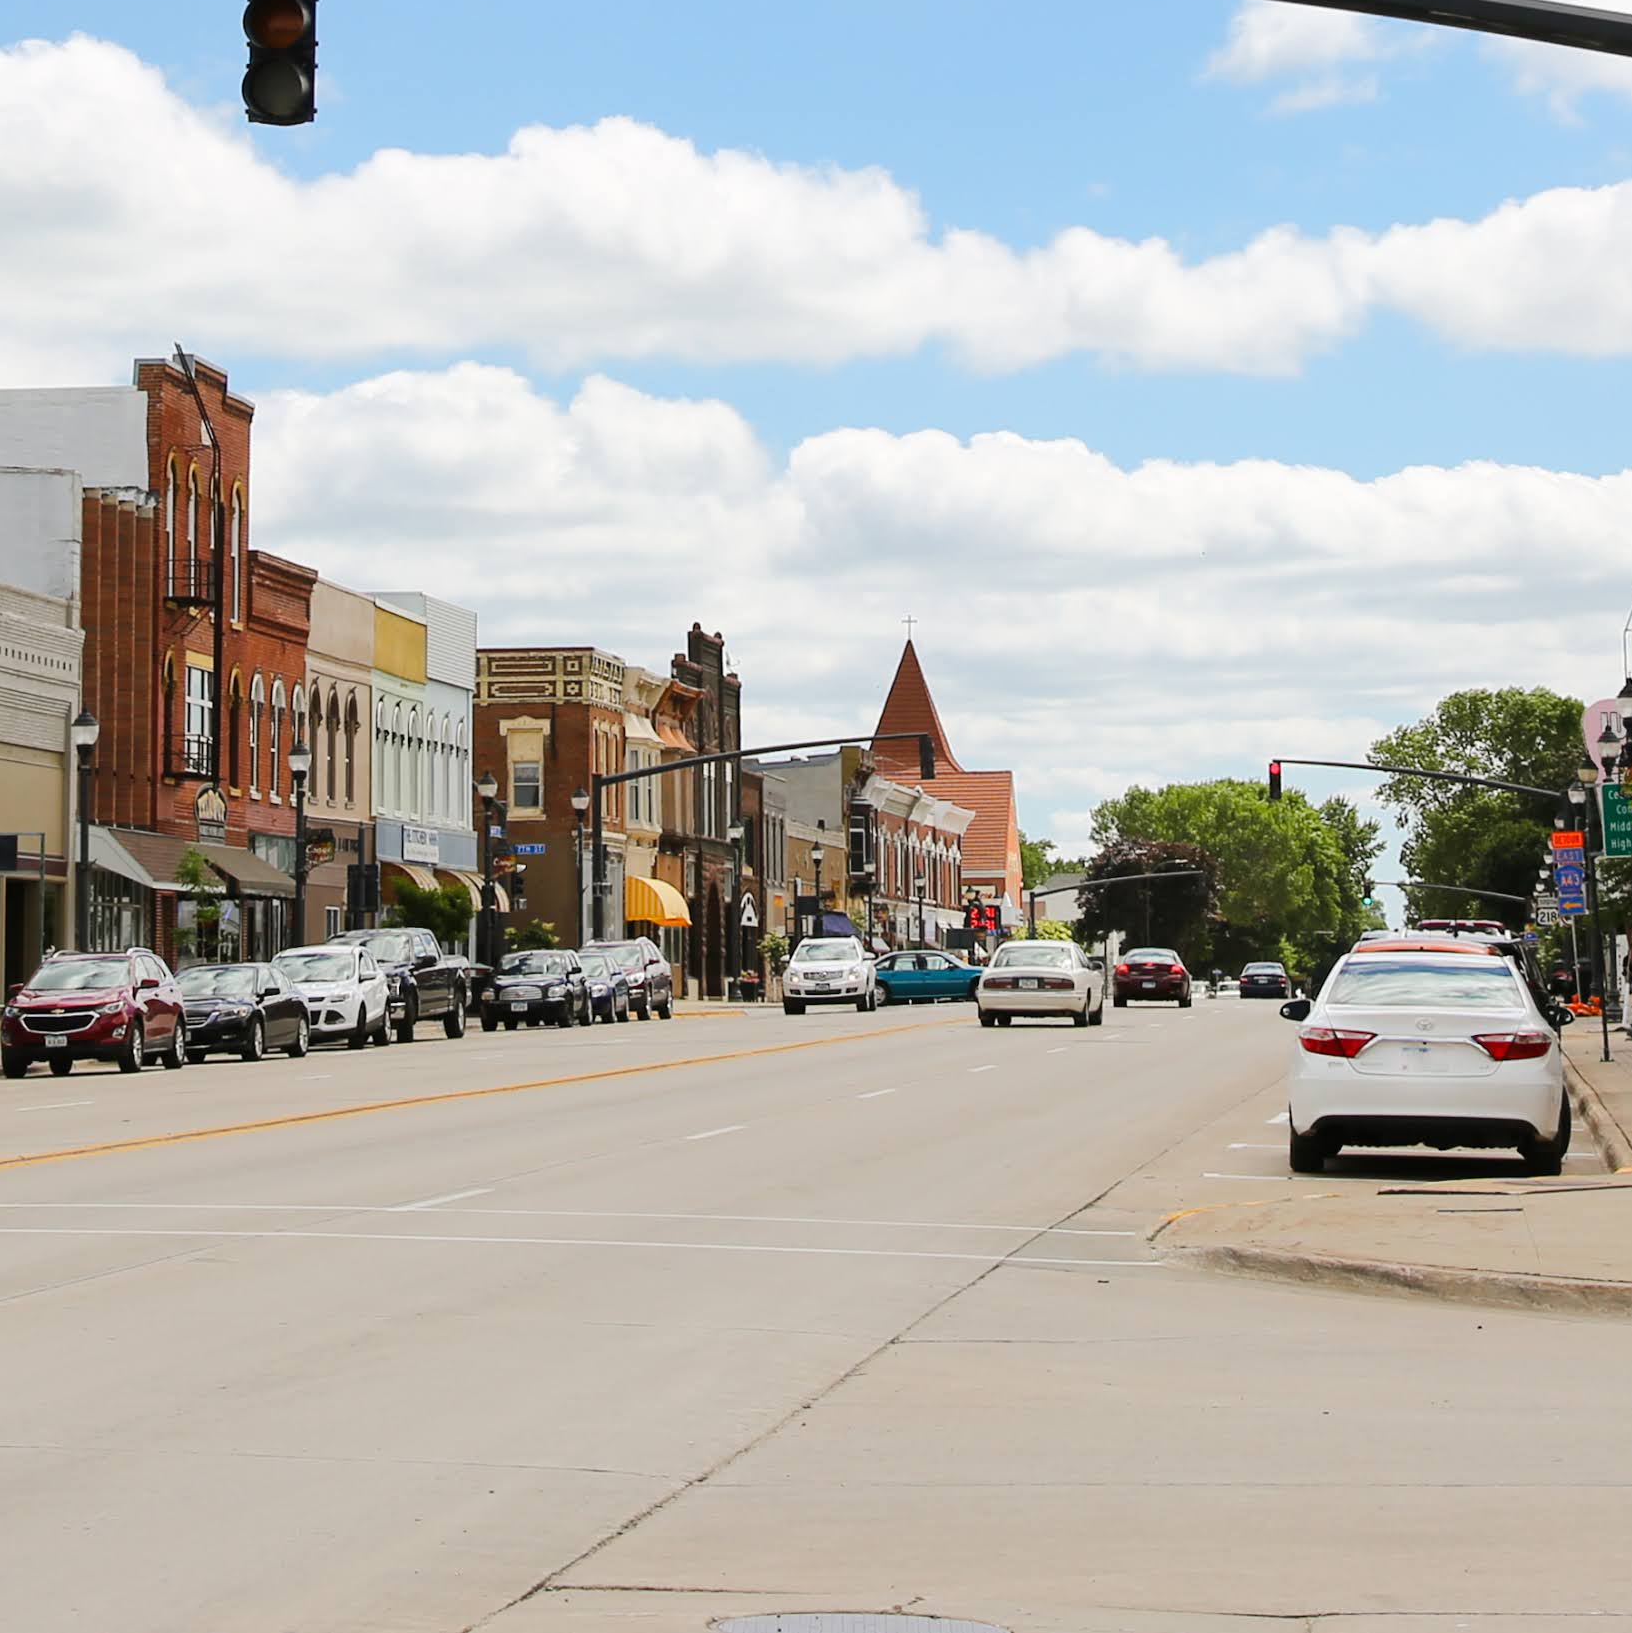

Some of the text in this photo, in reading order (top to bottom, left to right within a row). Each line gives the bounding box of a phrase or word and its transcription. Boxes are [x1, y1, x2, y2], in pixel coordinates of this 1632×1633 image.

[1554, 834, 1580, 845] DETOUR
[1611, 839, 1632, 851] High
[1556, 850, 1580, 861] EAST
[1540, 911, 1558, 923] 218
